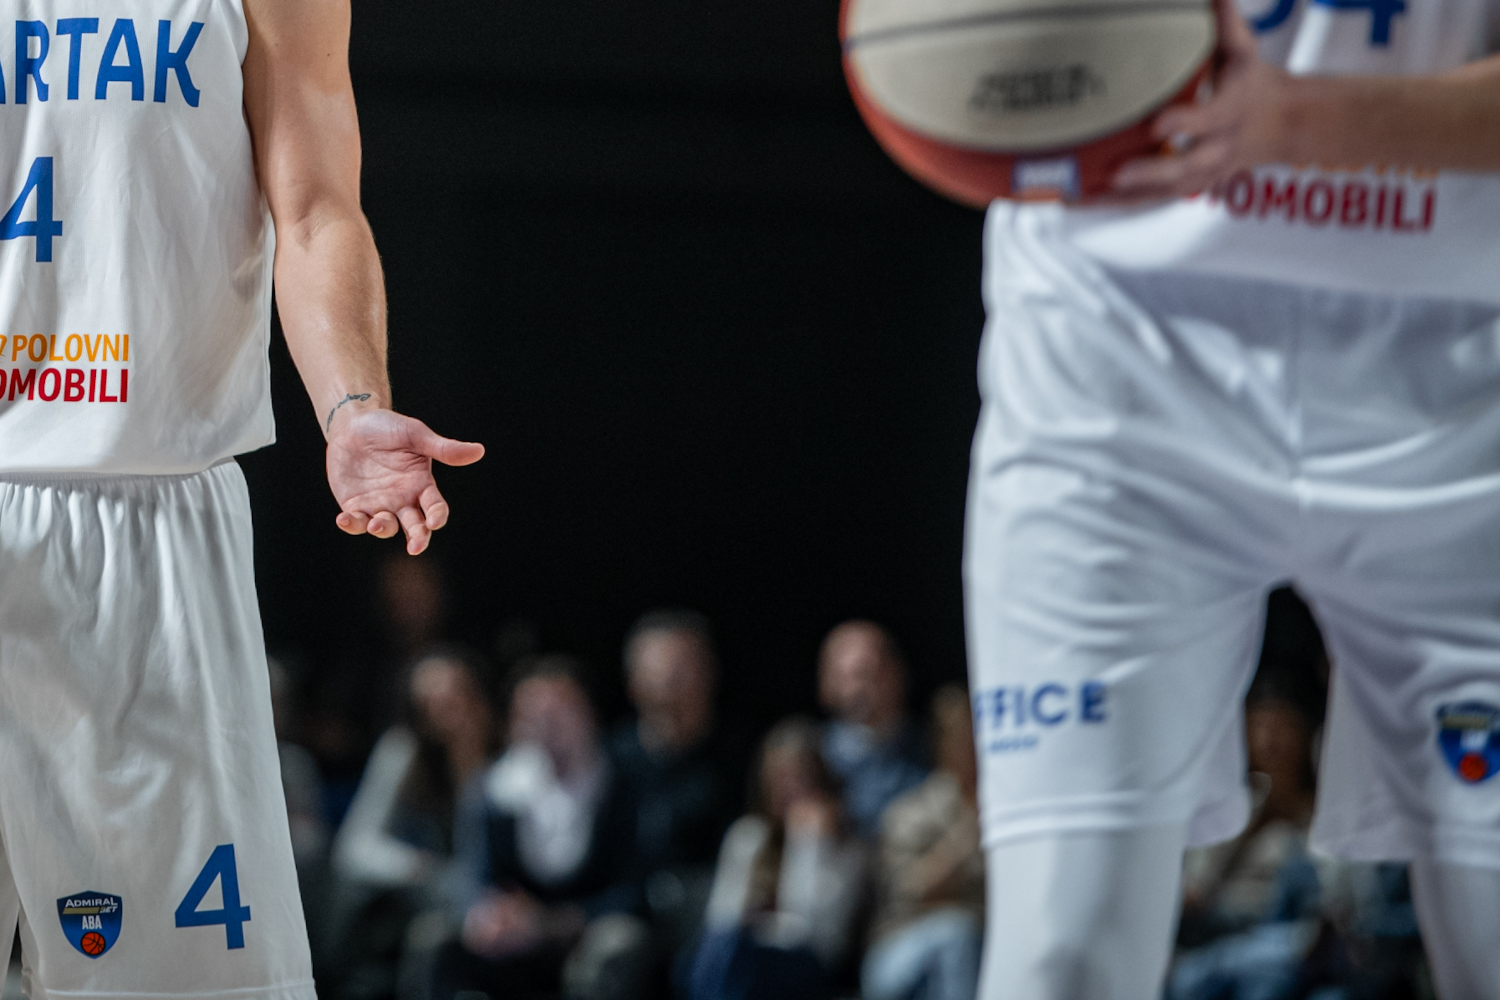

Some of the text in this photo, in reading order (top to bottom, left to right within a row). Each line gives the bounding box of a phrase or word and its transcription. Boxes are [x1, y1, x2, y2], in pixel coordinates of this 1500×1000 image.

[1222, 172, 1438, 236] OMOBILI
[11, 333, 130, 363] POLOVNI
[65, 897, 118, 908] ADMIRAL
[174, 843, 252, 951] 4
[82, 915, 102, 930] ABA
